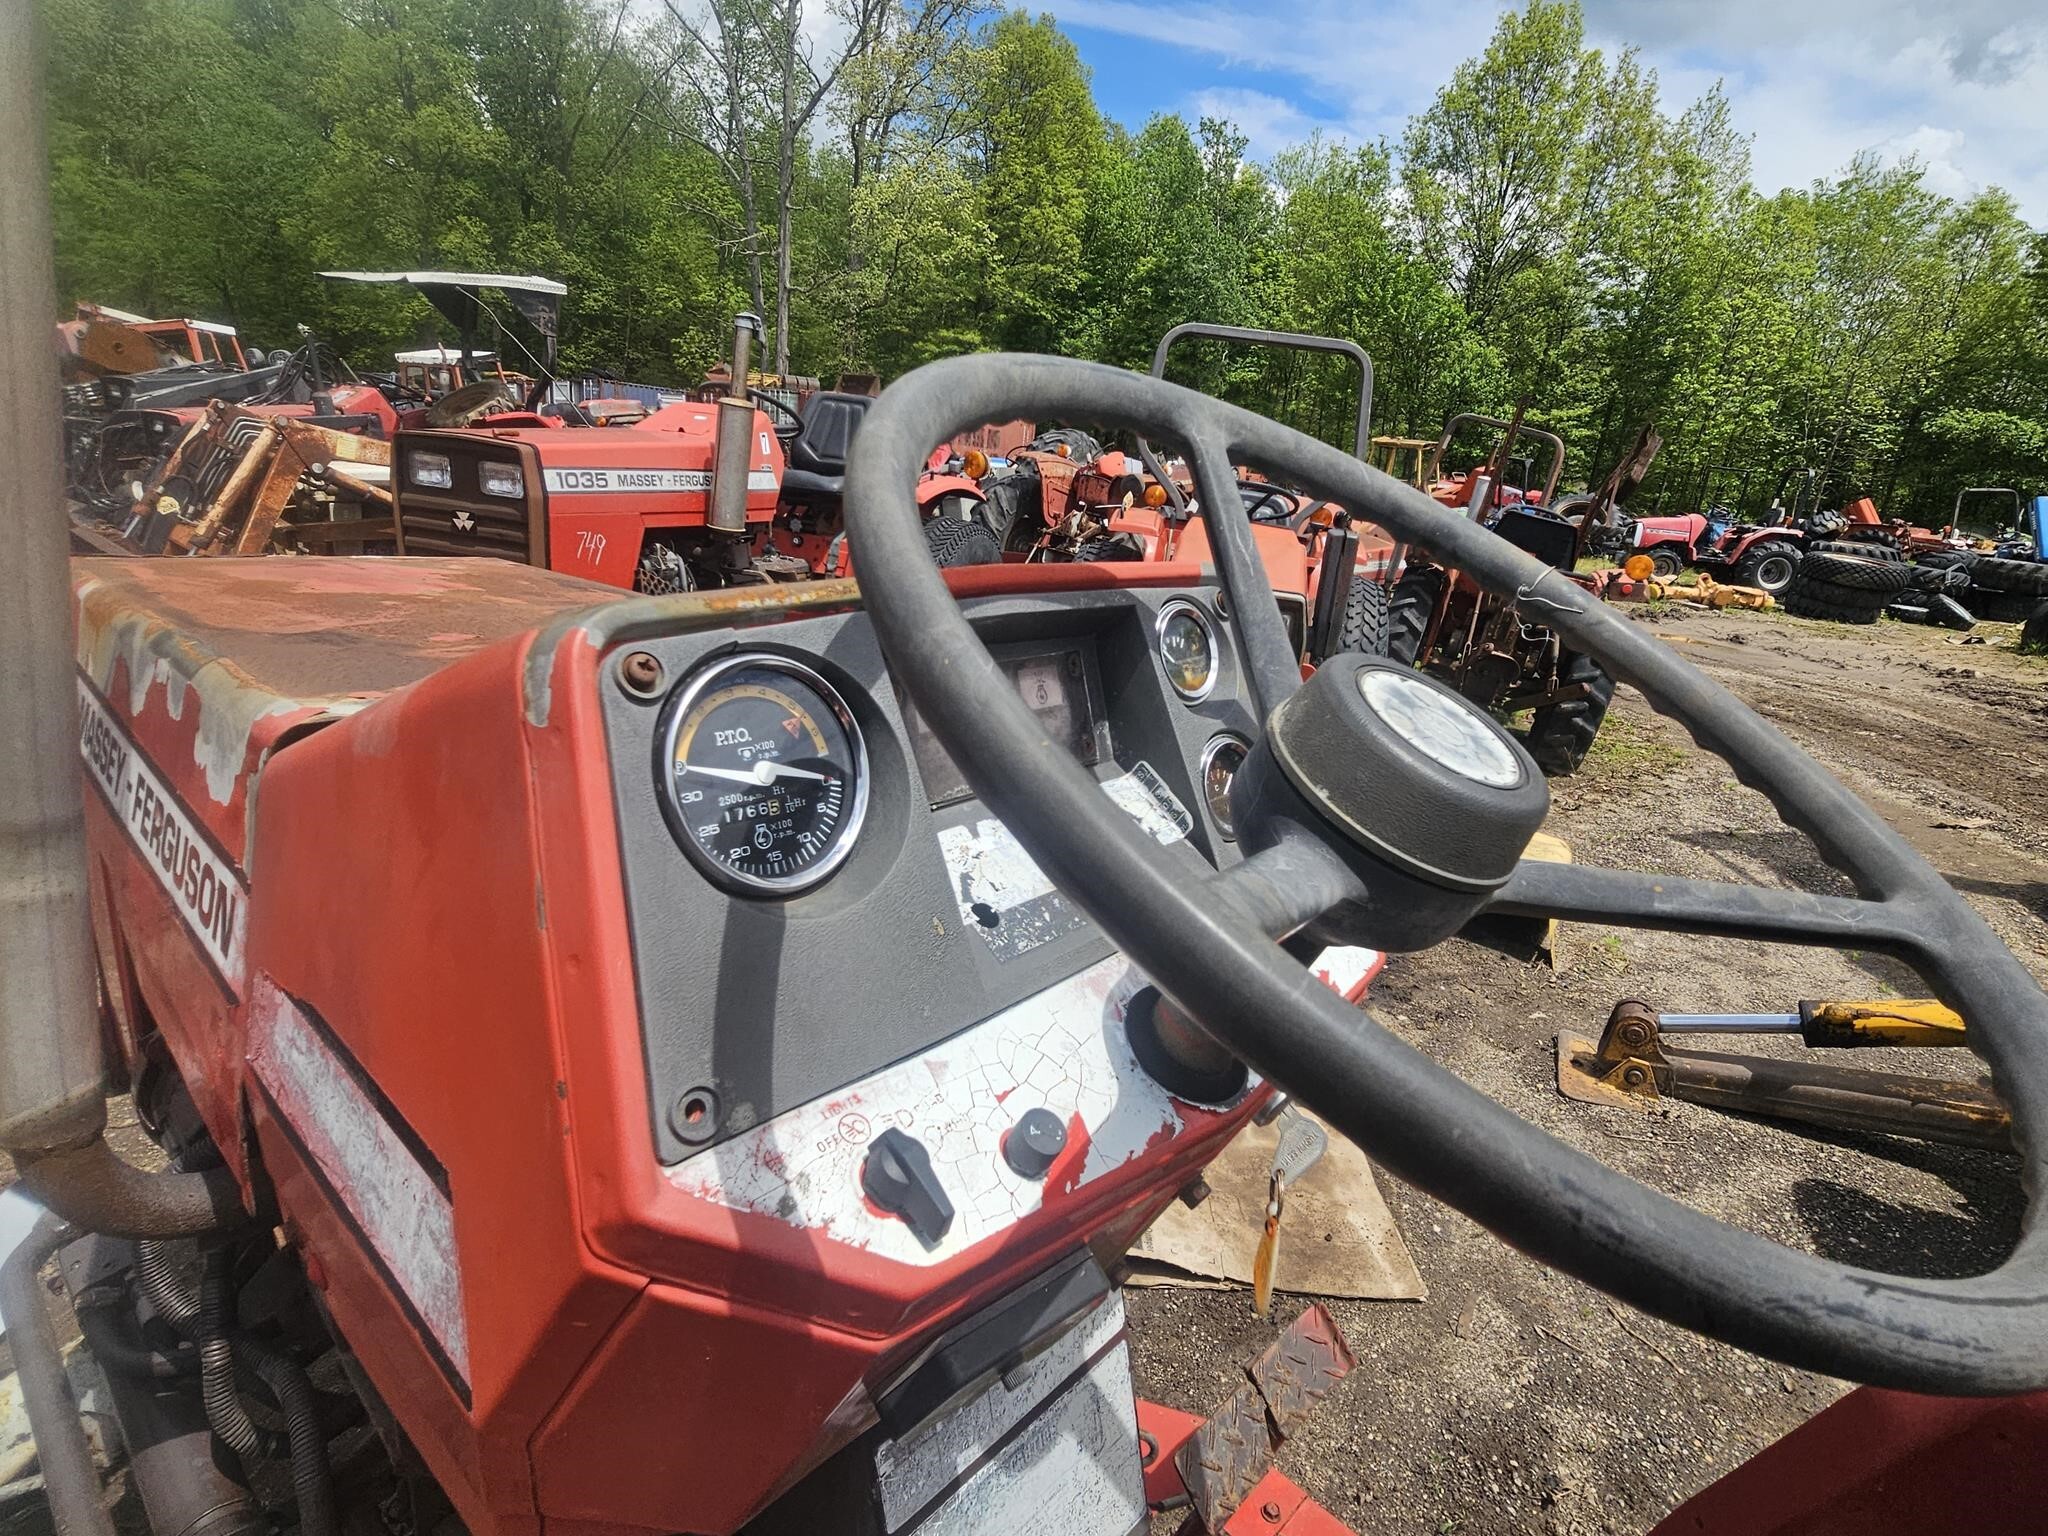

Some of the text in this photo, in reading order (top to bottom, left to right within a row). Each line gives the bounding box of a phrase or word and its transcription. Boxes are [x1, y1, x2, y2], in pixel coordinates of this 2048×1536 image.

[556, 472, 608, 489] 1035
[617, 474, 664, 488] MASSEY
[673, 474, 713, 488] FERGUS
[577, 531, 607, 566] 749
[681, 790, 703, 804] 30
[816, 802, 827, 814] 5
[698, 823, 721, 837] 25
[796, 832, 812, 843] 10
[730, 845, 751, 860] 20
[767, 851, 783, 862] 15
[131, 772, 238, 960] FERGUSON
[816, 1133, 840, 1152] OFF
